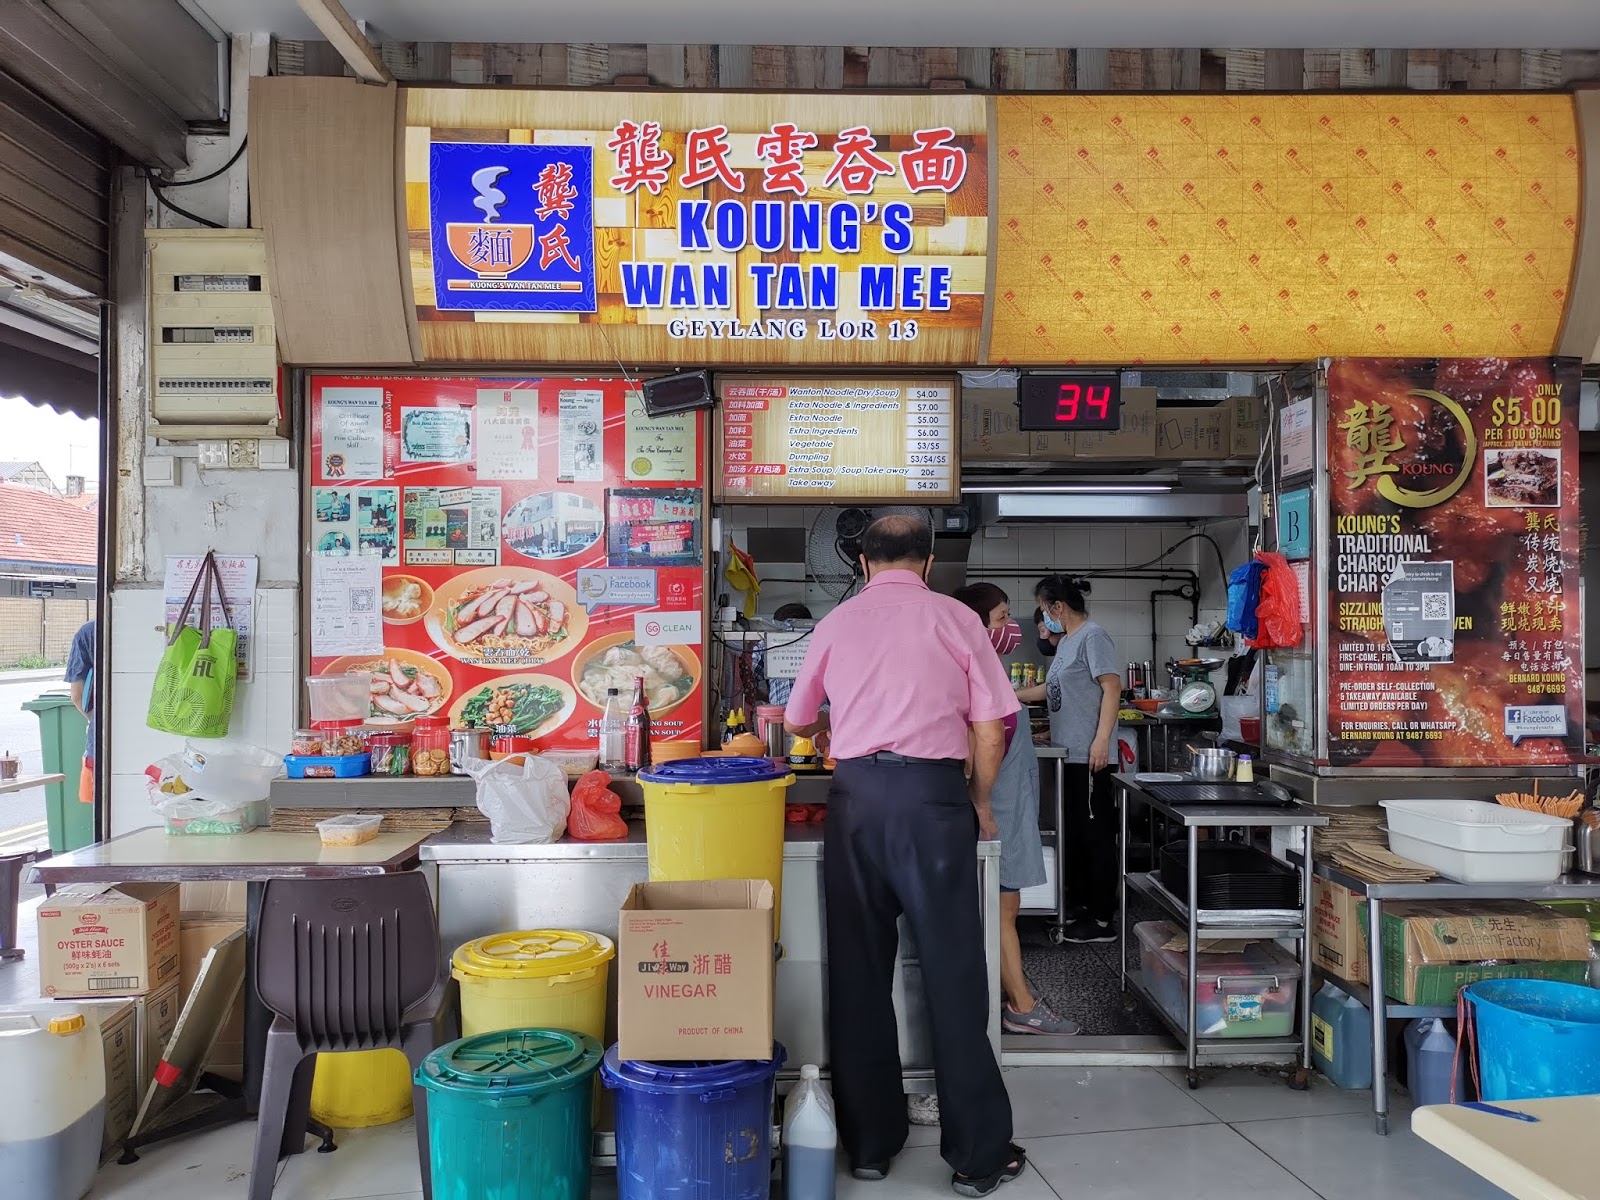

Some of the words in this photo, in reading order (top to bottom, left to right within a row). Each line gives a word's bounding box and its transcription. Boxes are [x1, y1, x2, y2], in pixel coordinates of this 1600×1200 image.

[608, 121, 966, 194] 龔氏雲吞面
[680, 201, 912, 252] KOUNG'S
[544, 282, 561, 290] MEE
[620, 264, 729, 309] WAN
[751, 264, 826, 309] TAN
[862, 265, 951, 311] MEE
[669, 319, 805, 339] GEYLANG
[818, 320, 876, 339] LOR
[890, 321, 918, 340] 13
[789, 388, 821, 396] Wanton
[823, 388, 899, 398] Noodle(Dry/Soup)
[917, 390, 938, 398] $4.00
[1537, 384, 1562, 396] ONLY
[385, 391, 393, 410] Map
[789, 401, 809, 409] Extra
[811, 401, 843, 409] Noodle
[845, 401, 851, 409] &
[853, 401, 900, 410] Ingredients
[918, 403, 938, 411] $7.00
[1056, 384, 1110, 421] 34
[1491, 397, 1562, 426] $5.00
[789, 413, 809, 422] Extra
[811, 414, 843, 422] Noodle
[918, 416, 939, 424] $5.00
[789, 427, 809, 435] Extra
[811, 427, 858, 436] Ingredients
[918, 429, 939, 437] $6.00
[1485, 429, 1502, 440] PER
[1507, 429, 1526, 439] 100
[1529, 428, 1561, 439] GRAMS
[728, 439, 746, 447] 油菜
[789, 440, 834, 449] Vegetable
[917, 442, 940, 450] $3/$5
[728, 452, 746, 460] 水饺
[789, 453, 829, 462] Dumpling
[910, 455, 946, 464] $3/$4/$5
[789, 466, 809, 474] Extra
[811, 466, 834, 475] Soup
[842, 467, 862, 475] Soup
[887, 468, 909, 476] away
[1402, 464, 1453, 475] KOUNG
[789, 479, 809, 487] Take
[811, 480, 834, 488] away
[1288, 510, 1300, 541] B
[1337, 515, 1401, 533] KOUNG'S
[1337, 535, 1431, 553] TRADITIONAL
[1524, 533, 1561, 552] 传统
[1524, 553, 1562, 574] 炭烧
[610, 580, 651, 588] Facebook
[1338, 573, 1378, 592] CHAR
[1525, 574, 1562, 594] 叉烧
[663, 624, 692, 632] CLEAN
[1340, 617, 1384, 631] STRAIGH
[1501, 616, 1562, 631] 现烧现卖
[1339, 644, 1365, 652] LIMITED
[1543, 640, 1564, 649] 打包
[1339, 653, 1380, 662] FIRST-COME,
[1339, 663, 1363, 671] DINE-IN
[1365, 663, 1384, 671] FROM
[1386, 663, 1404, 671] 10AM
[1415, 663, 1430, 671] 3PM
[1509, 674, 1540, 683] BERNARD
[1542, 673, 1566, 682] KOUNG
[1340, 682, 1375, 690] PRE-ORDER
[1377, 682, 1435, 690] SELF-COLLECTION
[1528, 685, 1545, 694] 9487
[1546, 684, 1566, 693] 6693
[1346, 692, 1381, 700] TAKEAWAY
[1382, 692, 1417, 700] AVAILABLE
[1340, 702, 1368, 710] (LIMITED
[1370, 702, 1396, 710] ORDERS
[1397, 702, 1410, 710] PER
[1411, 702, 1428, 710] DAY)
[1523, 714, 1561, 723] Facebook
[1341, 722, 1354, 730] FOR
[1355, 722, 1391, 730] ENQUIRIES,
[1410, 722, 1419, 730] OR
[1420, 722, 1456, 730] WHATSAPP
[1341, 731, 1372, 739] BERNARD
[1373, 731, 1395, 739] KOUNG
[1406, 731, 1423, 739] 9487
[1425, 731, 1443, 739] 6693
[57, 941, 93, 950] OYSTER
[95, 939, 125, 947] SAUCE
[692, 954, 732, 975] 浙醋
[644, 984, 717, 998] VINEGAR
[724, 1026, 743, 1034] CHINA
